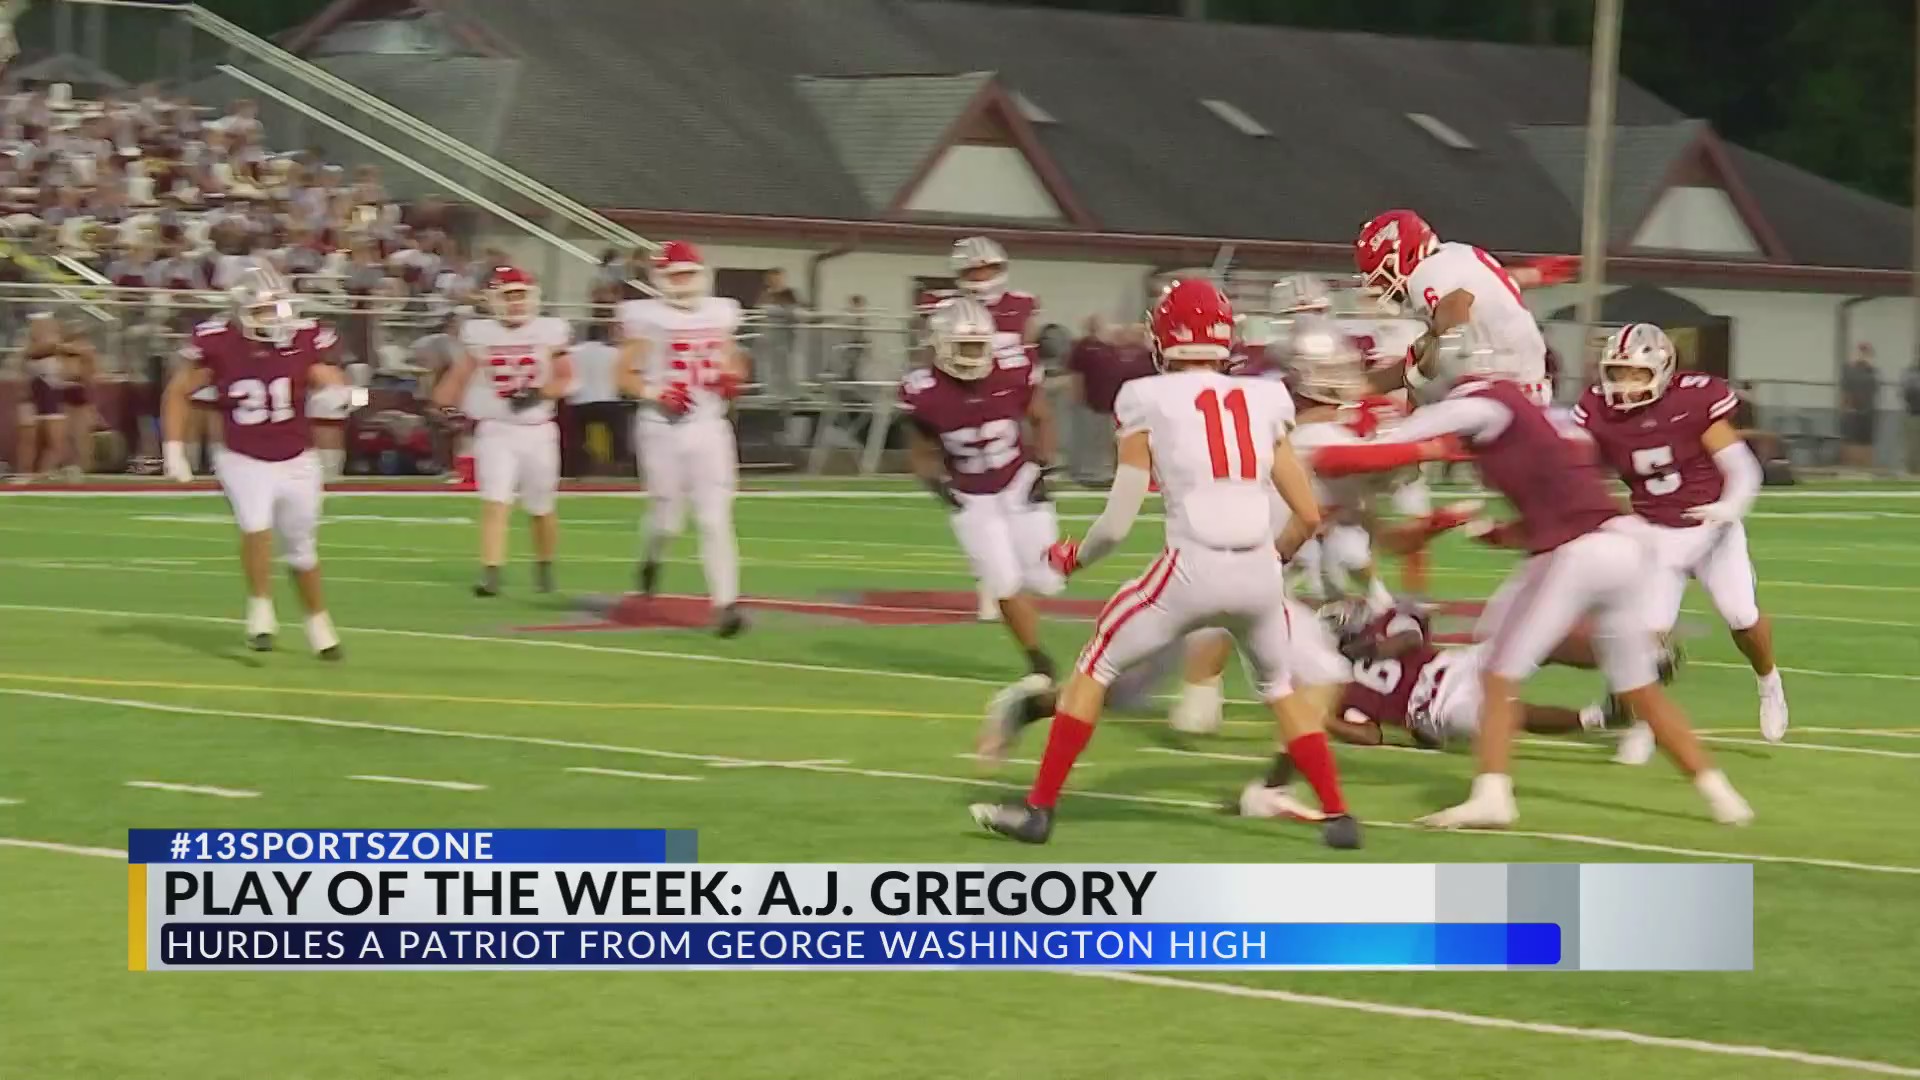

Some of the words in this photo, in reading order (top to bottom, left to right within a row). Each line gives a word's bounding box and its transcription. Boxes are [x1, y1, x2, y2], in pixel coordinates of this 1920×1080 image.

[228, 376, 296, 426] 31
[939, 418, 1022, 474] 52
[1194, 387, 1257, 480] 11
[1631, 445, 1683, 496] 5
